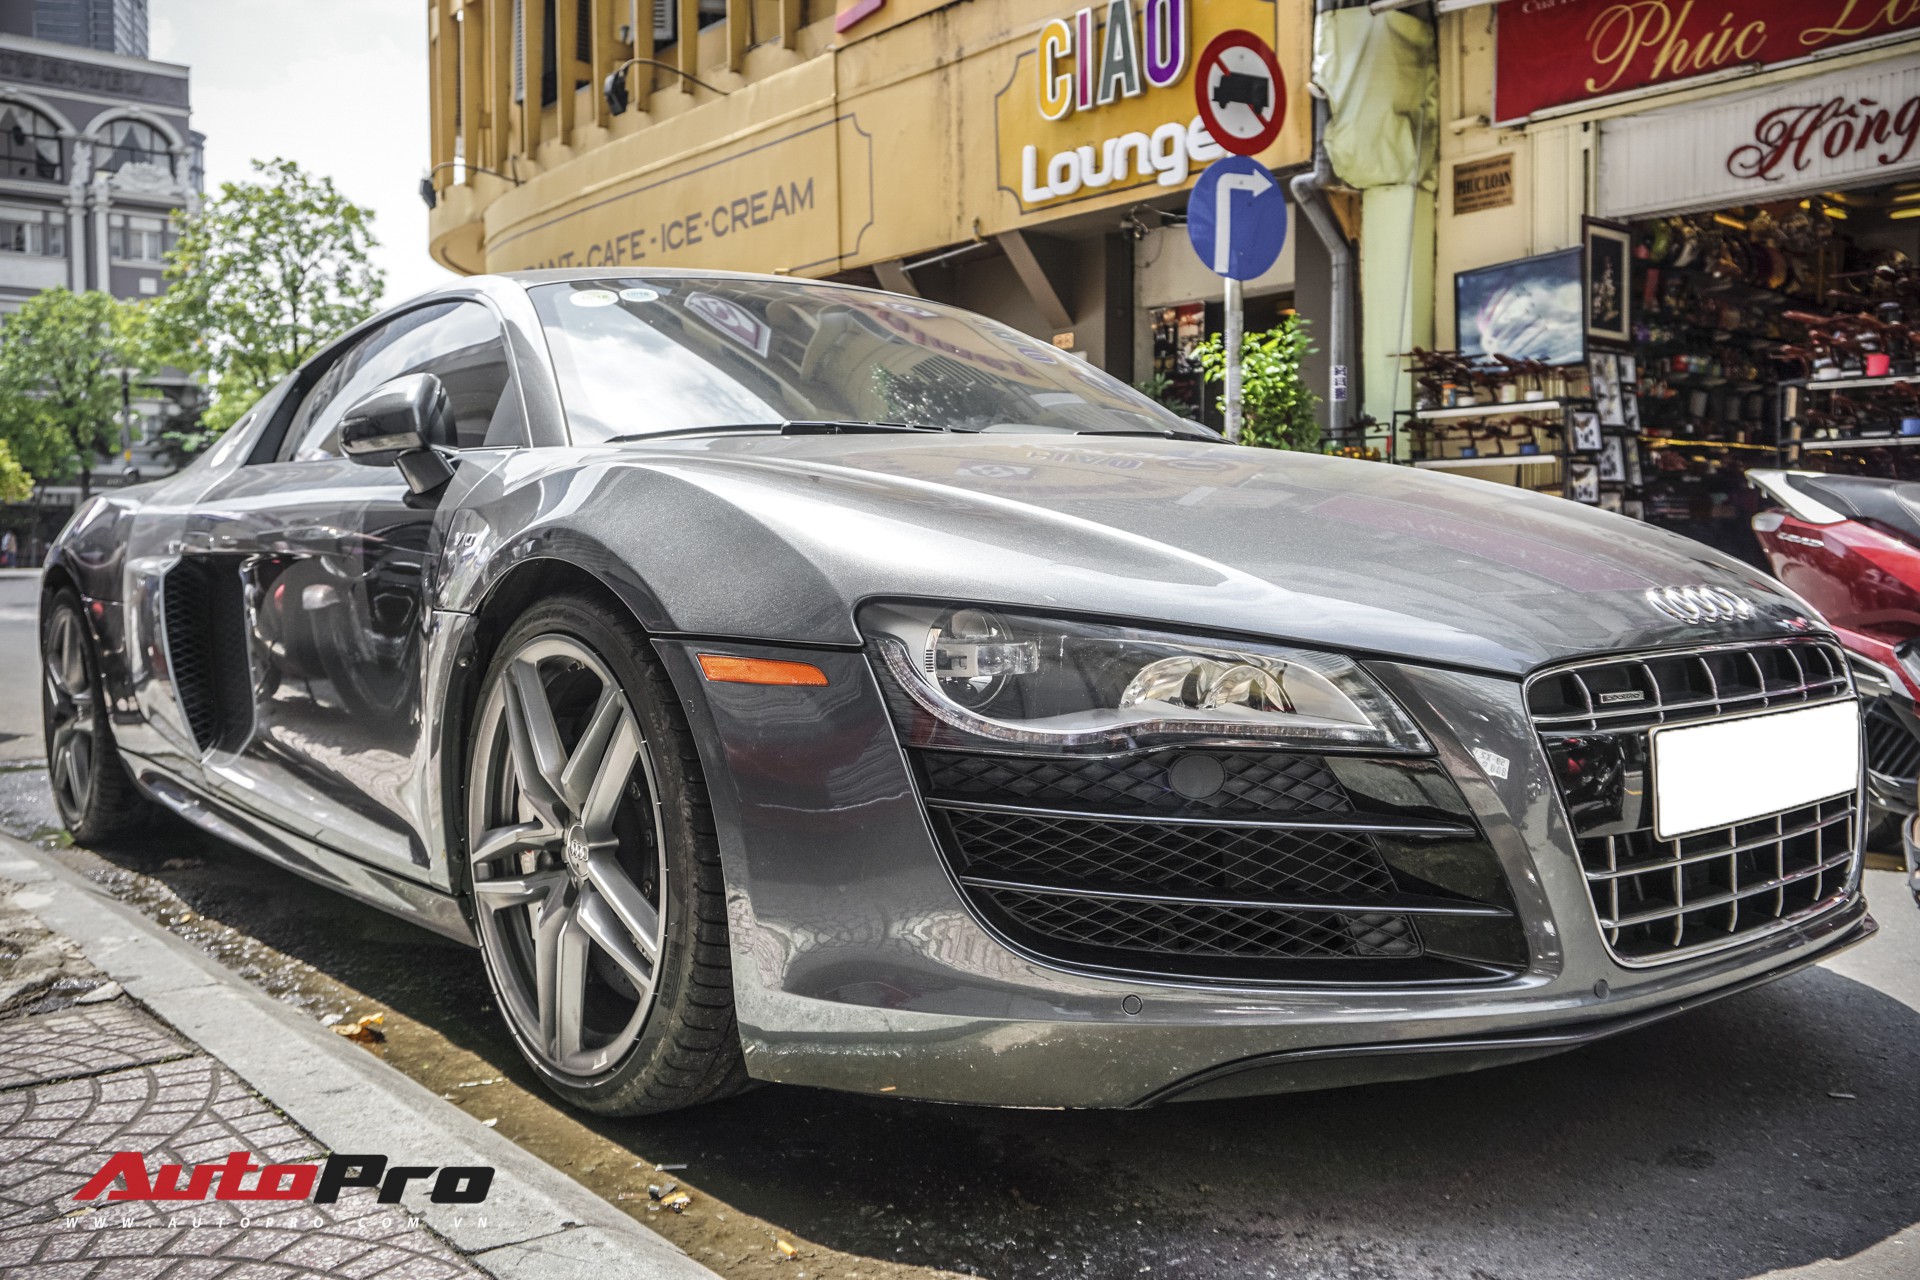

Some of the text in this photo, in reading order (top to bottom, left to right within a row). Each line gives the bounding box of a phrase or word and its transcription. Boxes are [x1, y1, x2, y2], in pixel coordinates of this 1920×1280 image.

[1038, 0, 1190, 121] CIAO
[1585, 0, 1767, 92] Phúc
[1022, 115, 1228, 202] Lounge
